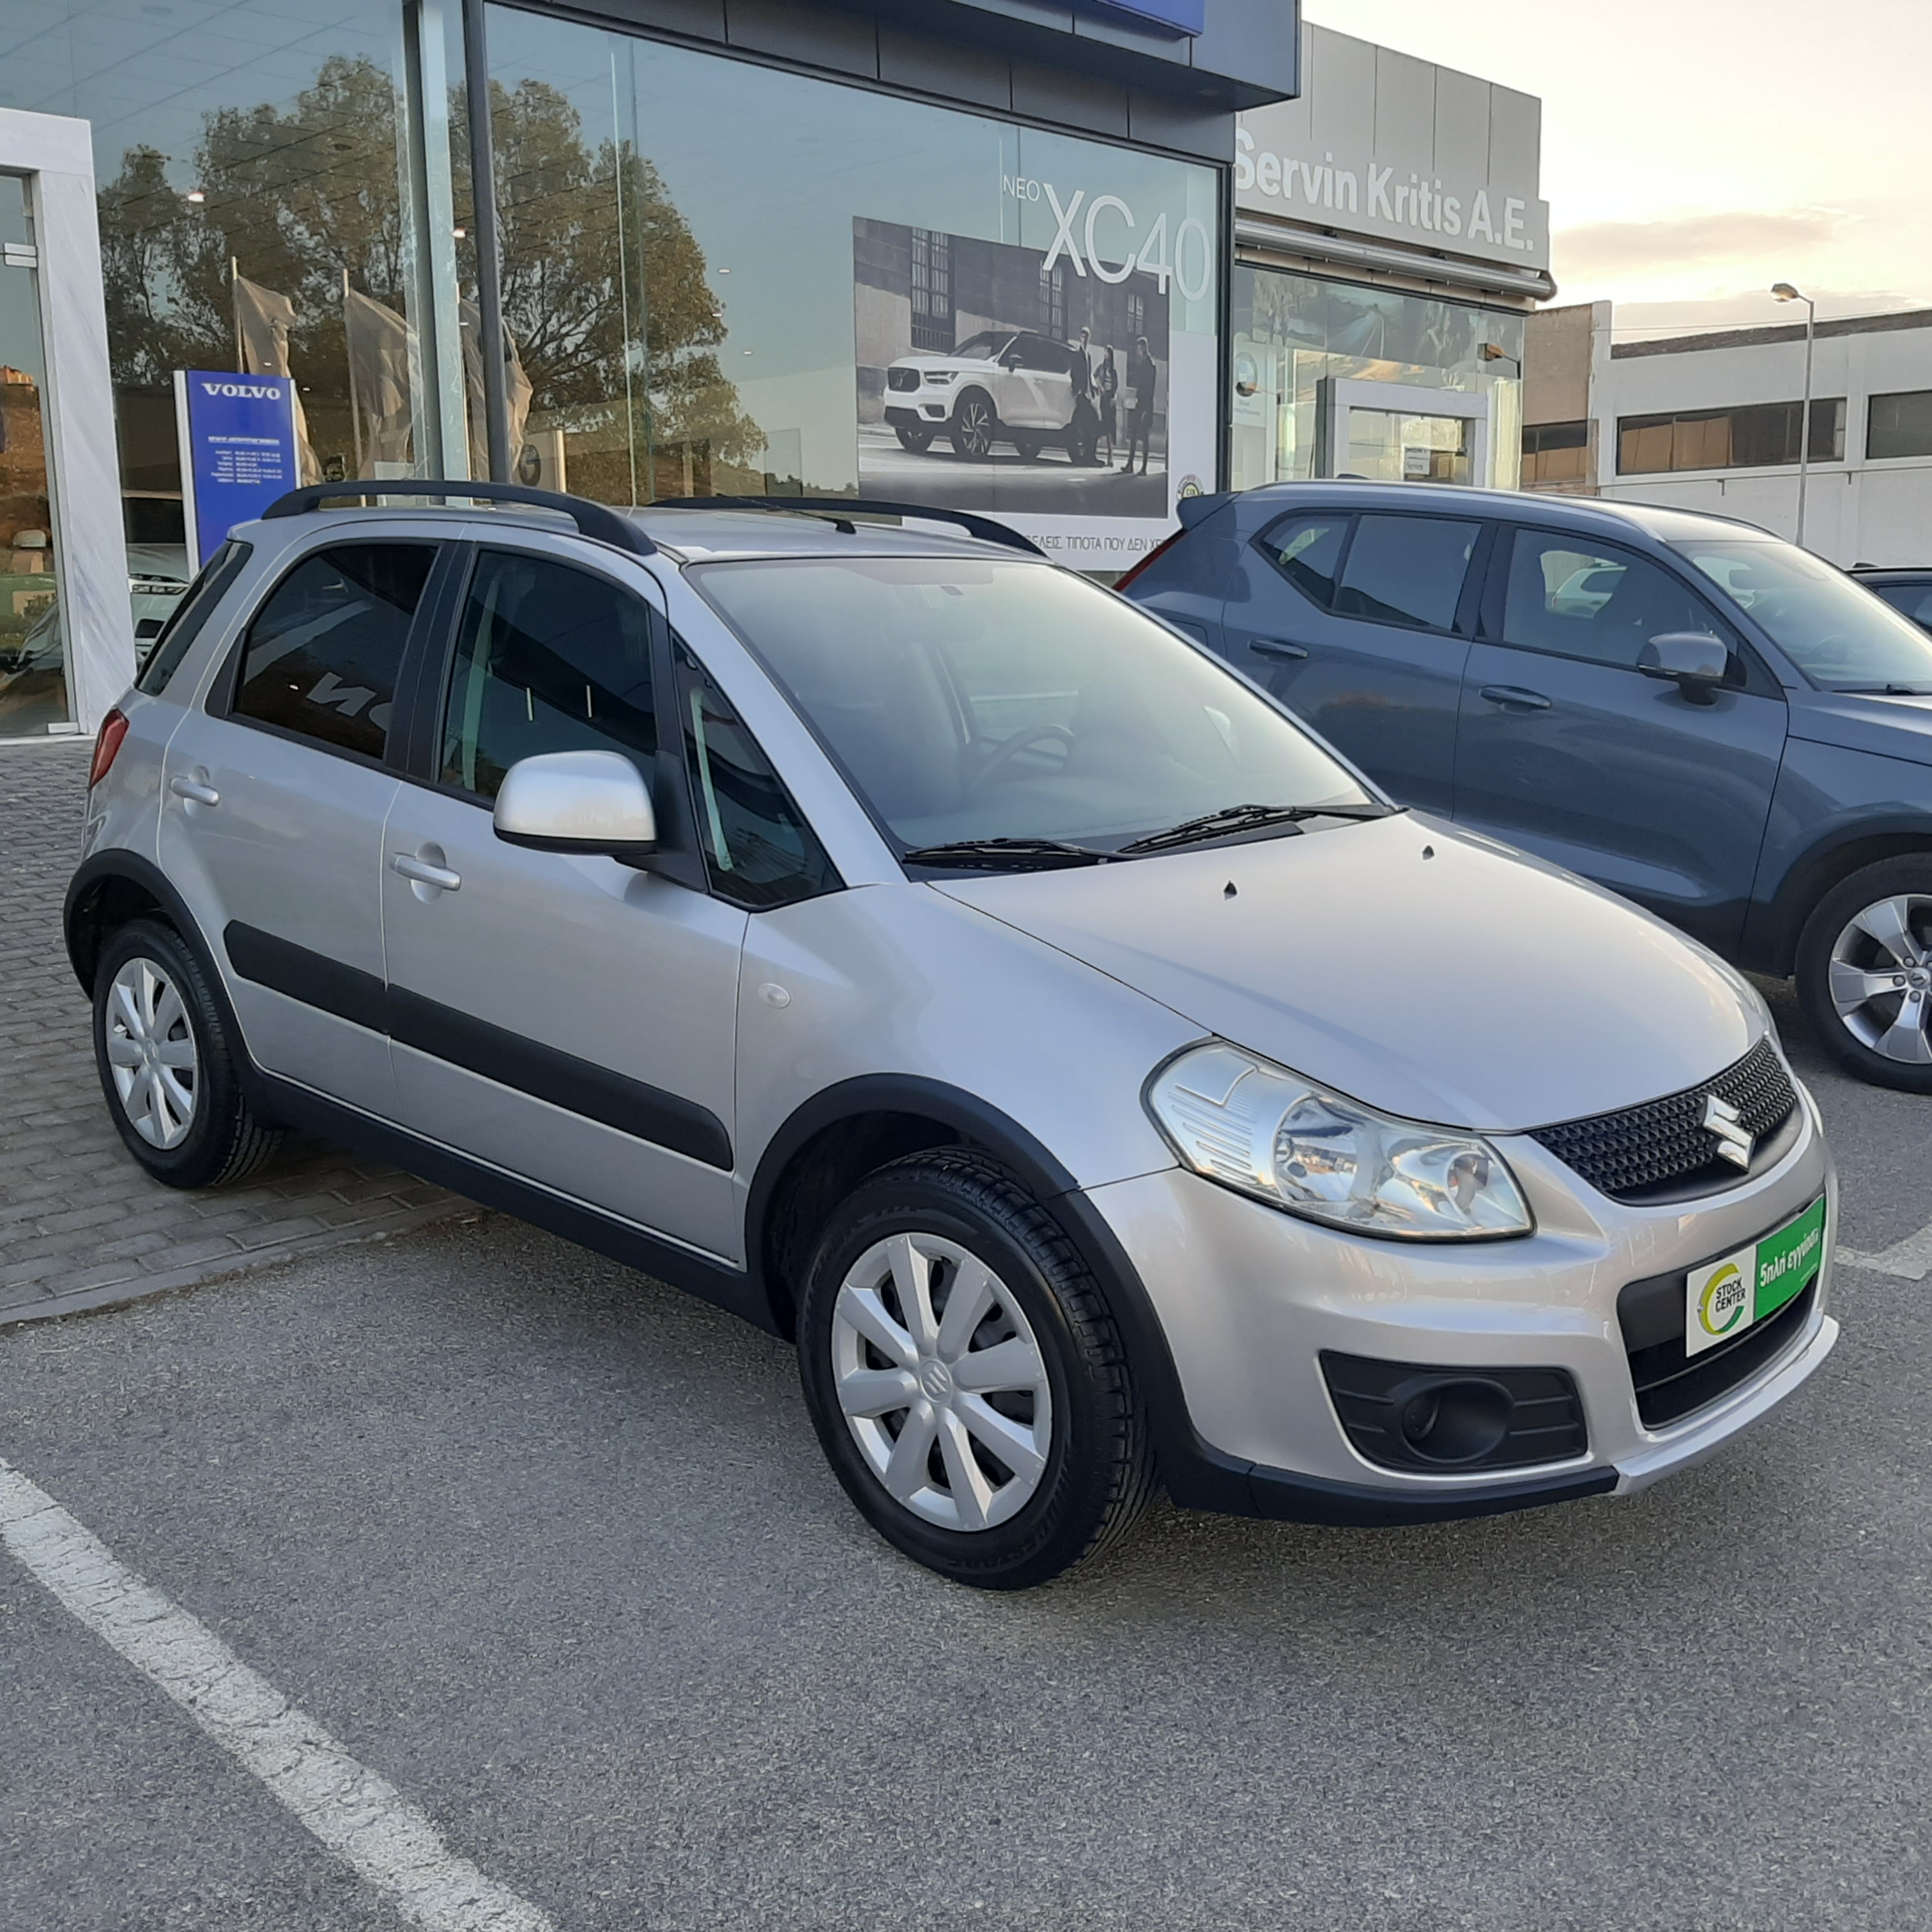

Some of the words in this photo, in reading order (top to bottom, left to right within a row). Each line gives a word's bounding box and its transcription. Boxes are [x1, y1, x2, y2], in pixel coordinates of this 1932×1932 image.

[1236, 127, 1358, 214] Servin
[1367, 162, 1461, 236] Kritis
[1468, 189, 1533, 252] A.E.
[1042, 182, 1211, 301] XC40
[201, 383, 281, 400] VOLVO
[1065, 536, 1102, 550] ΤΙΠΟΤΑ
[1104, 537, 1126, 551] ΠΟΥ
[1127, 538, 1147, 551] ΔΕΝ
[1715, 1287, 1746, 1313] CENTER
[1716, 1276, 1743, 1300] STOCK
